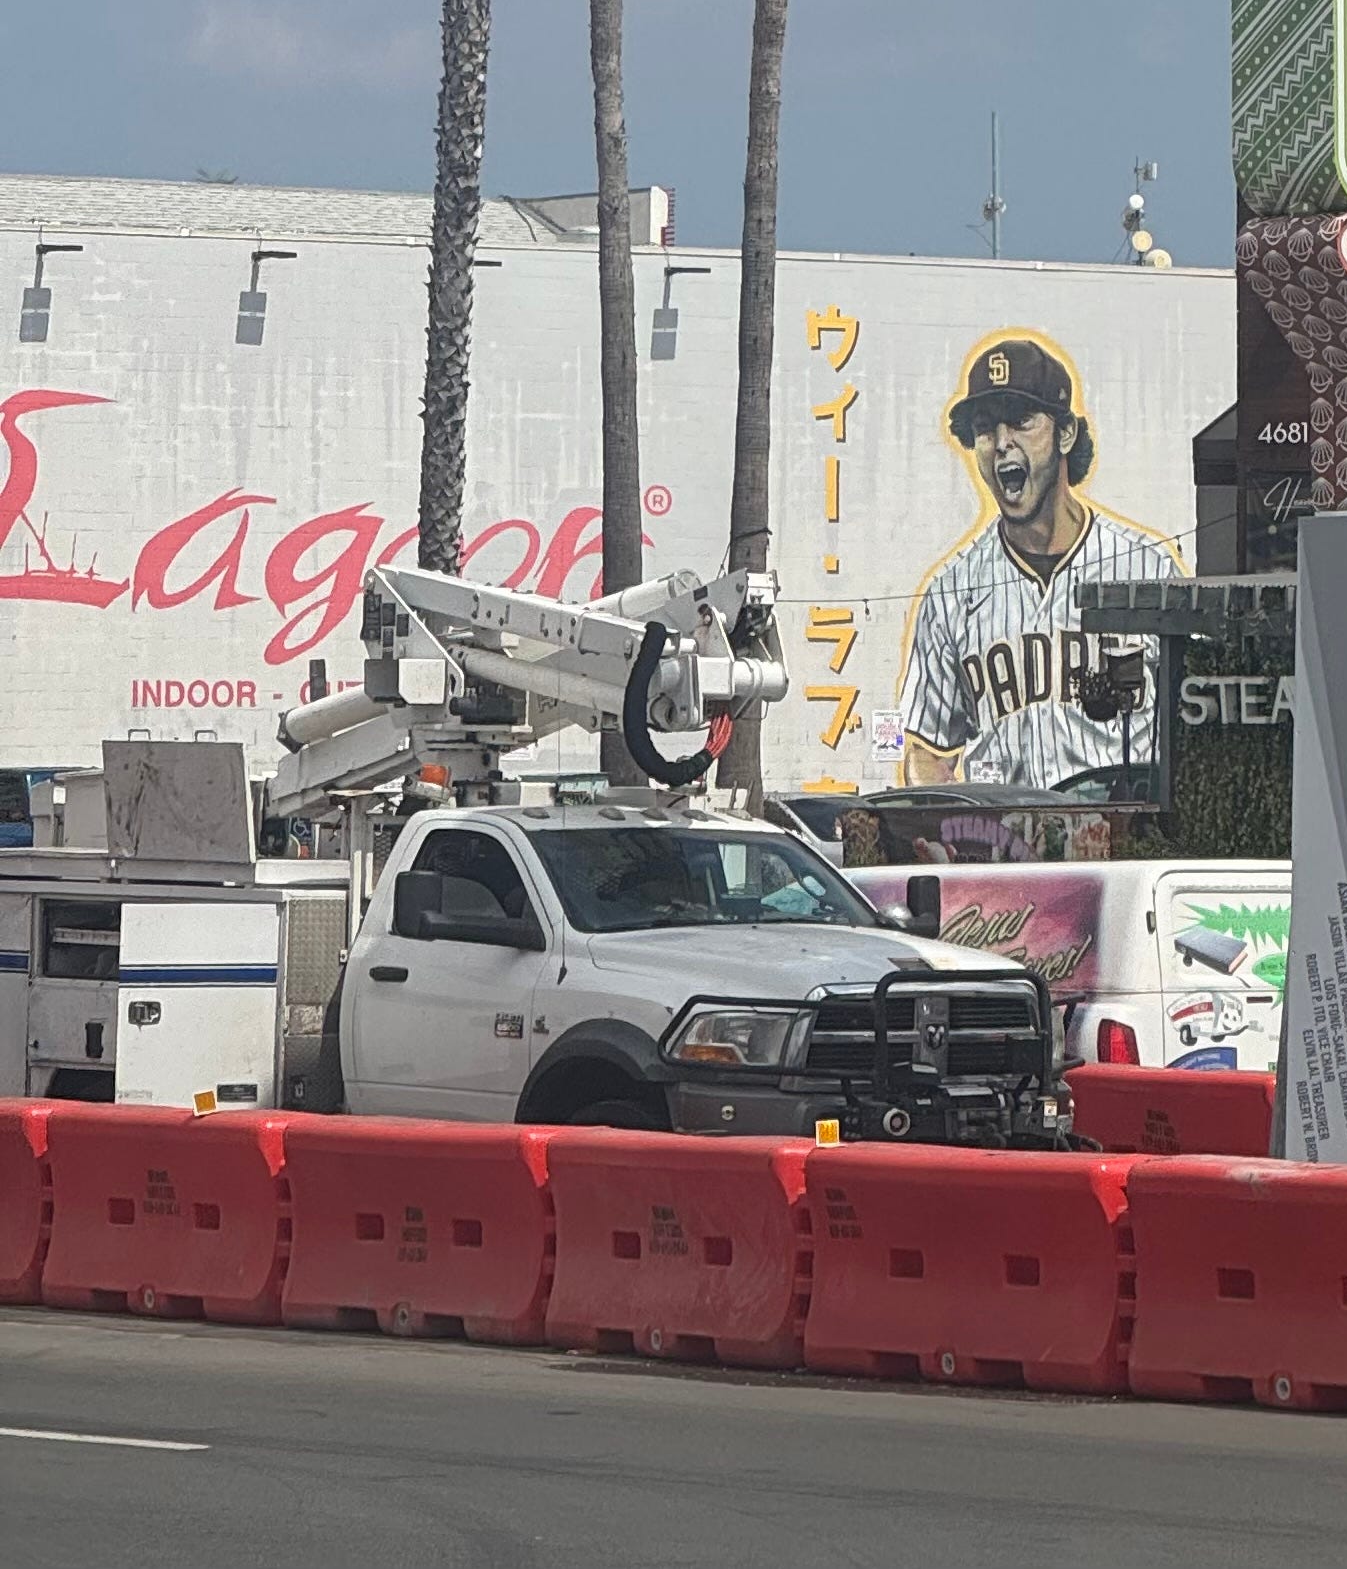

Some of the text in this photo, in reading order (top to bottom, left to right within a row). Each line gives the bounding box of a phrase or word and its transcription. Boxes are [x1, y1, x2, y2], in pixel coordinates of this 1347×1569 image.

[1258, 421, 1308, 444] 4681
[804, 303, 862, 795] ウィー・ラブ
[131, 679, 257, 708] INDOOR
[962, 630, 1148, 728] PADR
[1328, 915, 1343, 948] JASON
[1305, 953, 1322, 993] ROBERT
[1323, 978, 1338, 1001] LOIS
[1316, 1027, 1331, 1051] VICE
[1320, 1052, 1336, 1083] CHAIR
[1296, 1081, 1312, 1120] ROBERT
[1302, 1029, 1317, 1058] ELVIN
[1311, 1081, 1330, 1141] TREASURER
